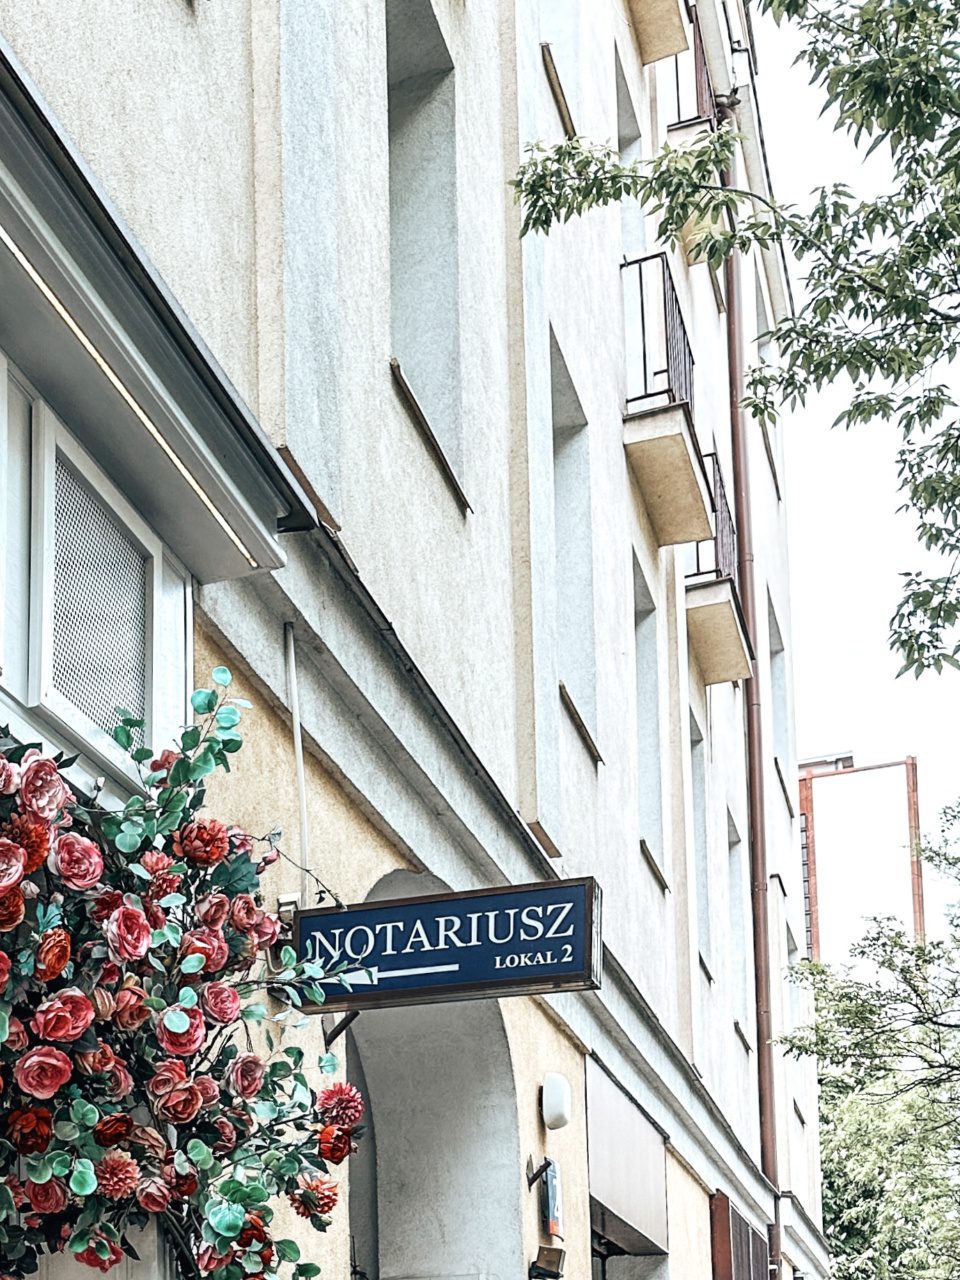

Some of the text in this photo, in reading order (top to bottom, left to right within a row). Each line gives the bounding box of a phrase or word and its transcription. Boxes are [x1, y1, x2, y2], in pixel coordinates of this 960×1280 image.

[310, 902, 575, 963] NOTARIUSZ
[494, 944, 574, 969] LOKAL 2
